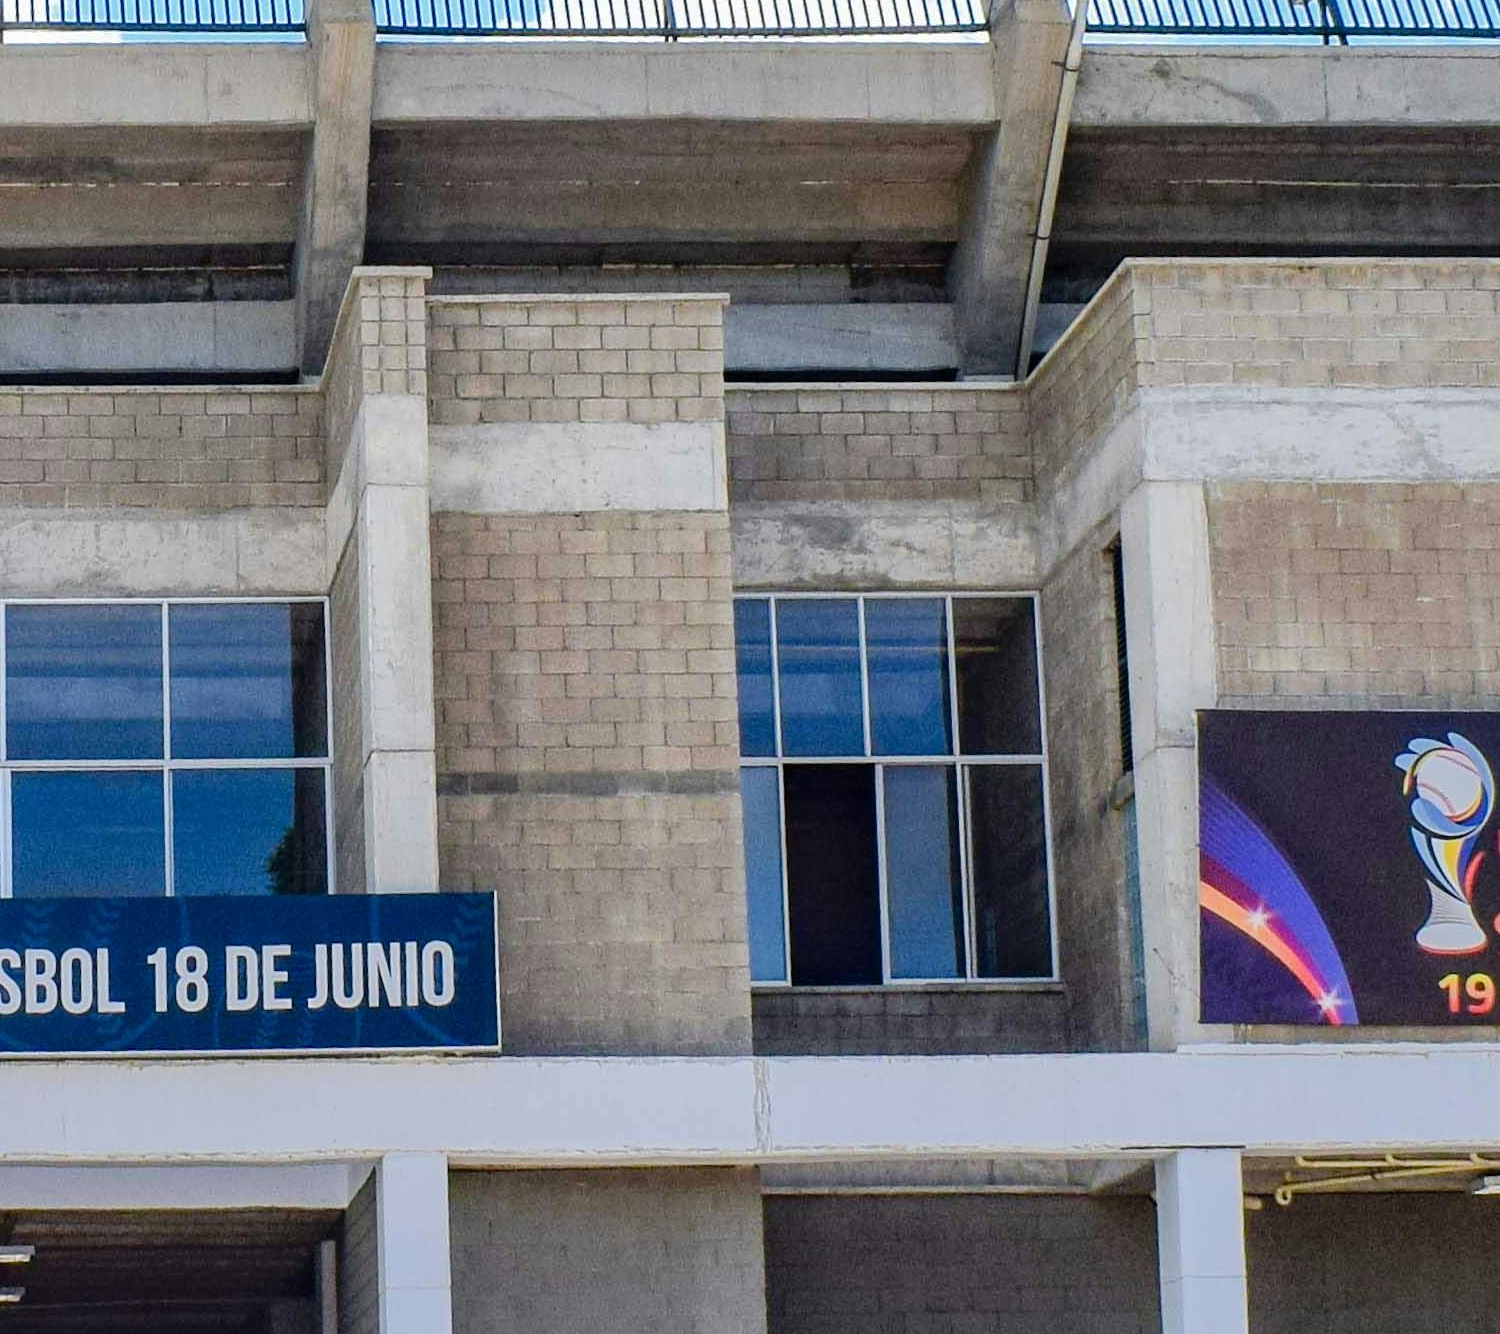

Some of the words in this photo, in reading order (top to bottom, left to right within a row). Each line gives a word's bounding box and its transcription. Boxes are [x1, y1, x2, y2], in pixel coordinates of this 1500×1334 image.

[147, 946, 209, 1013] 18
[226, 944, 292, 1012] DE
[307, 939, 456, 1010] JUNIO
[1438, 973, 1496, 1014] 19
